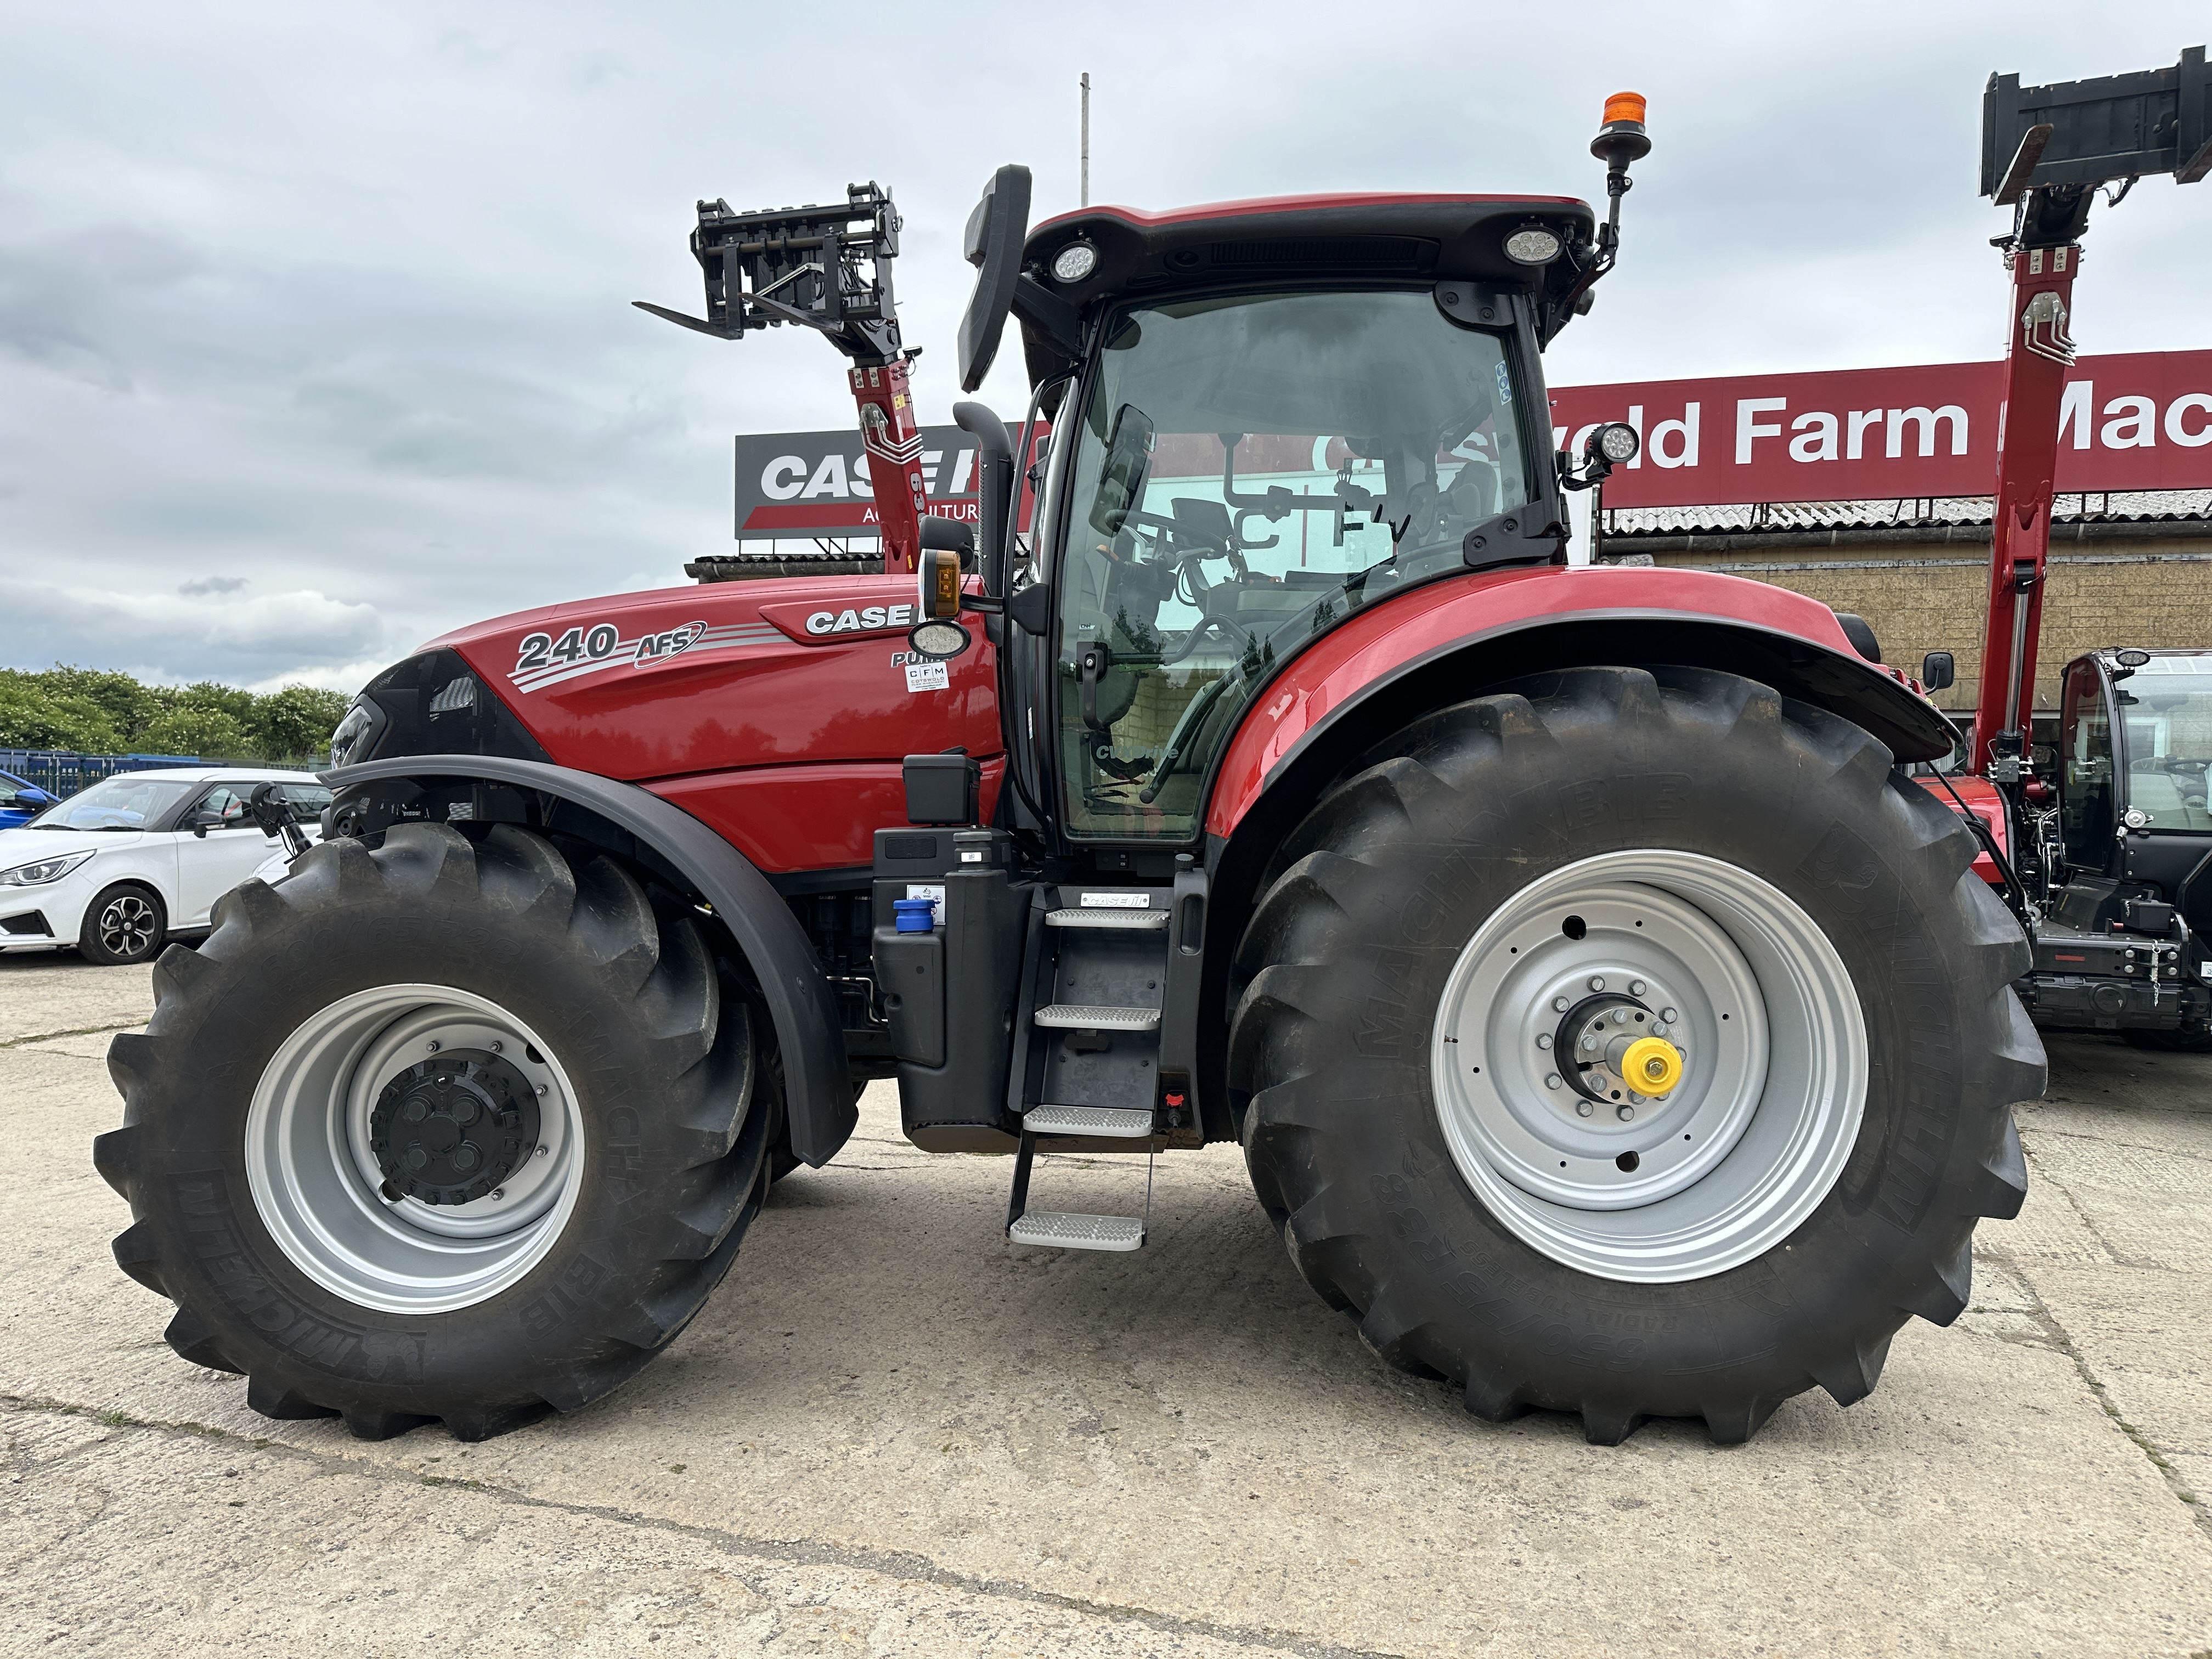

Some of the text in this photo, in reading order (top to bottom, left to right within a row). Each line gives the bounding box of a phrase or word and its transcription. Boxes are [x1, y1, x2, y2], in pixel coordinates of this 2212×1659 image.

[1735, 397, 1968, 465] Farm
[805, 604, 913, 634] CASE
[516, 624, 692, 670] 240 AFS
[891, 651, 954, 668] PU
[1096, 745, 1179, 759] CVXDrive
[1088, 896, 1128, 906] CASE
[1863, 895, 1954, 1227] MICHELIN
[178, 1181, 358, 1367] MICHELIN
[1457, 1236, 1678, 1334] RADIAL TUBELESS
